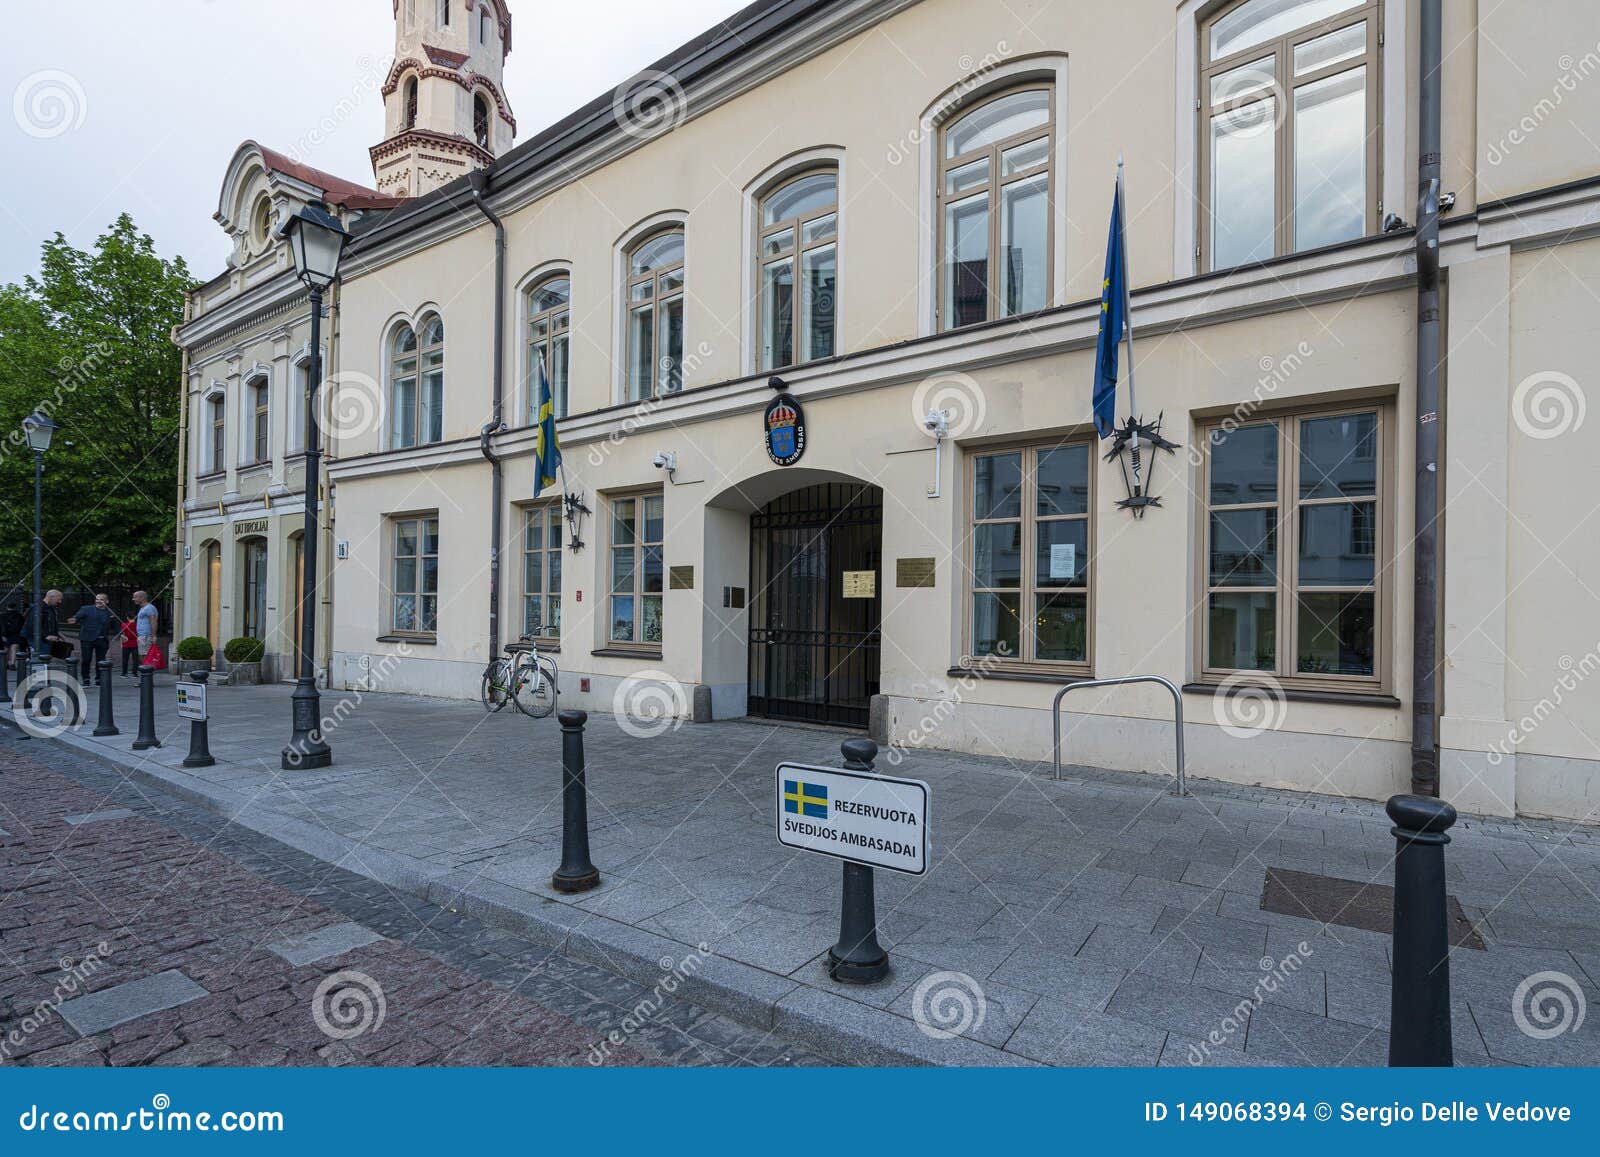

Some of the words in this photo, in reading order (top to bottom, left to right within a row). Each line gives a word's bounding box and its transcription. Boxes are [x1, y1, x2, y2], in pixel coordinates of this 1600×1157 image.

[834, 799, 917, 826] REZERVUOTA
[784, 818, 838, 841] ŠVEDIJOS
[839, 831, 916, 858] AMBASADAI
